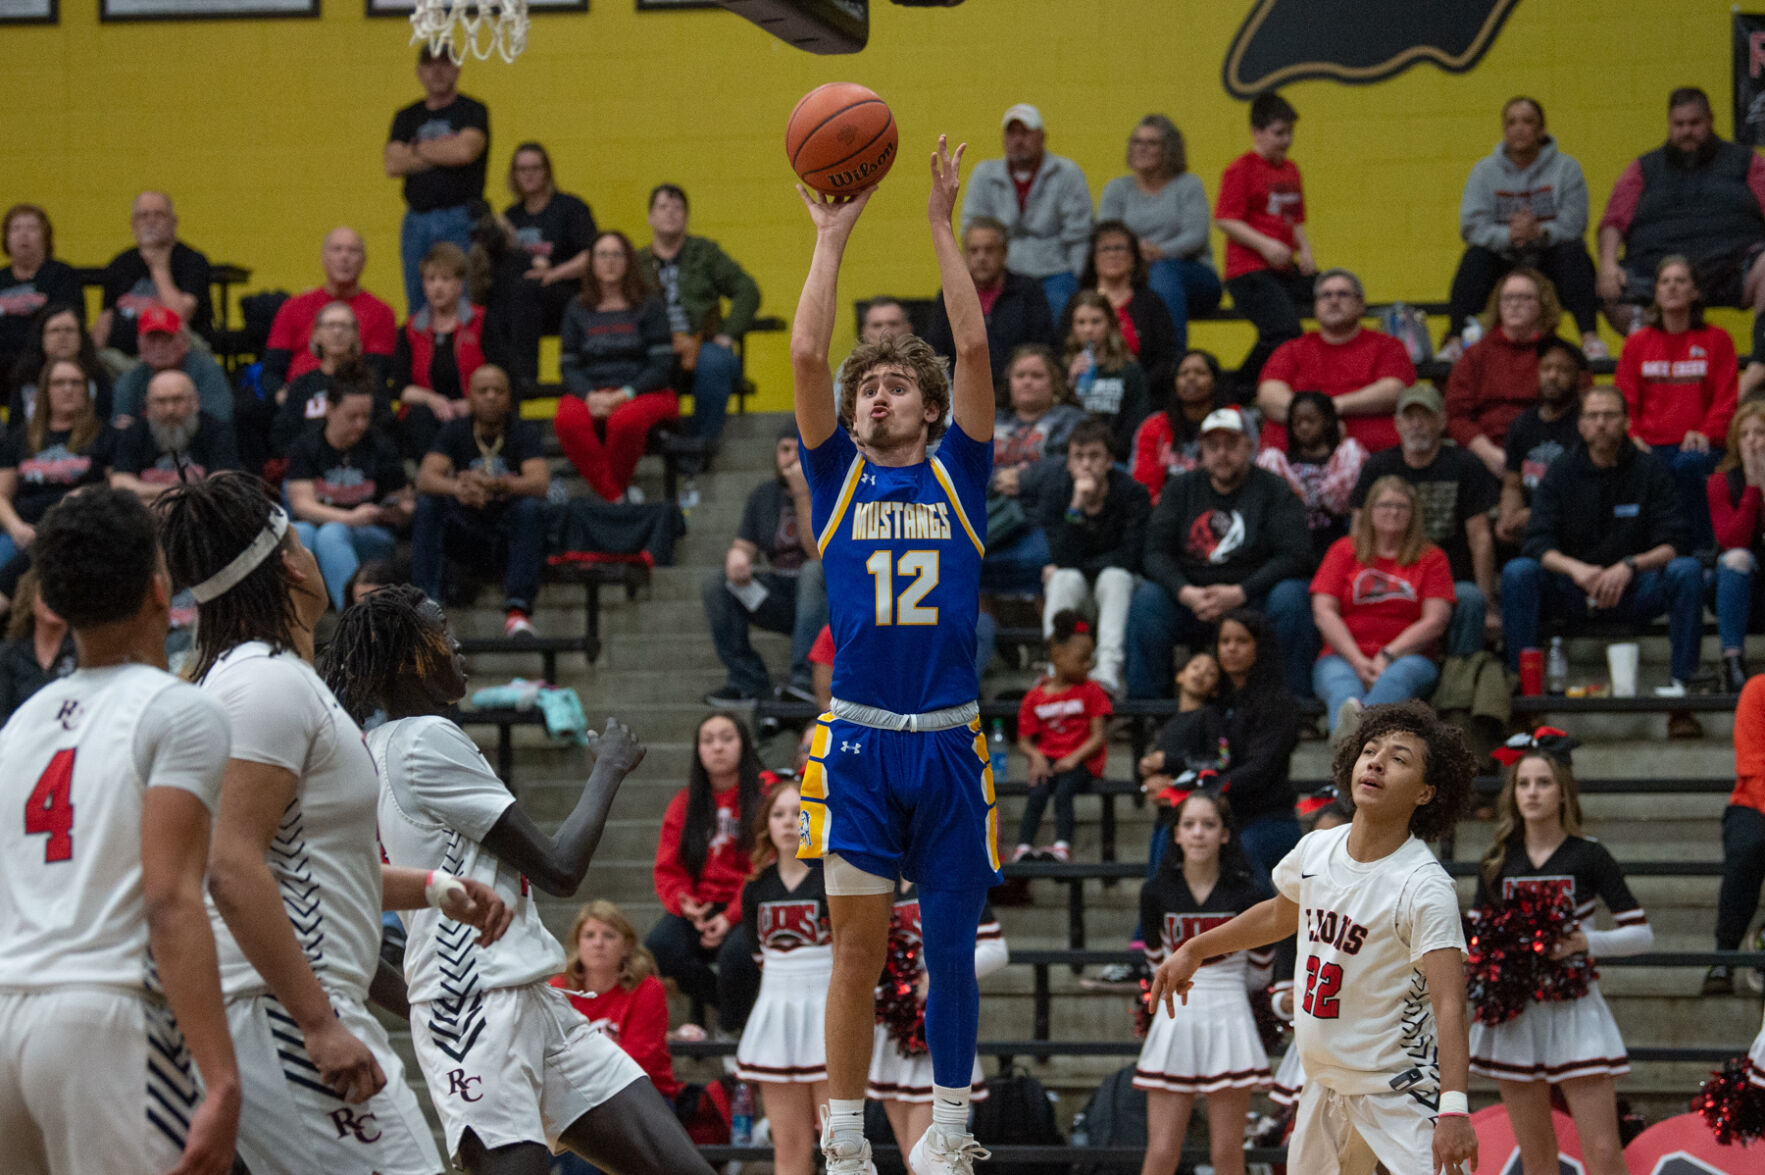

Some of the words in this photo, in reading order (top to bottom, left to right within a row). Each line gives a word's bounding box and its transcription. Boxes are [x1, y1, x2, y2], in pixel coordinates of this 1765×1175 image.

[828, 142, 894, 187] Wilson
[852, 501, 952, 541] MUSTANGS
[866, 550, 940, 626] 12
[25, 746, 78, 864] 4
[1302, 954, 1344, 1019] 22
[446, 1068, 484, 1103] RC
[328, 1107, 382, 1144] RC
